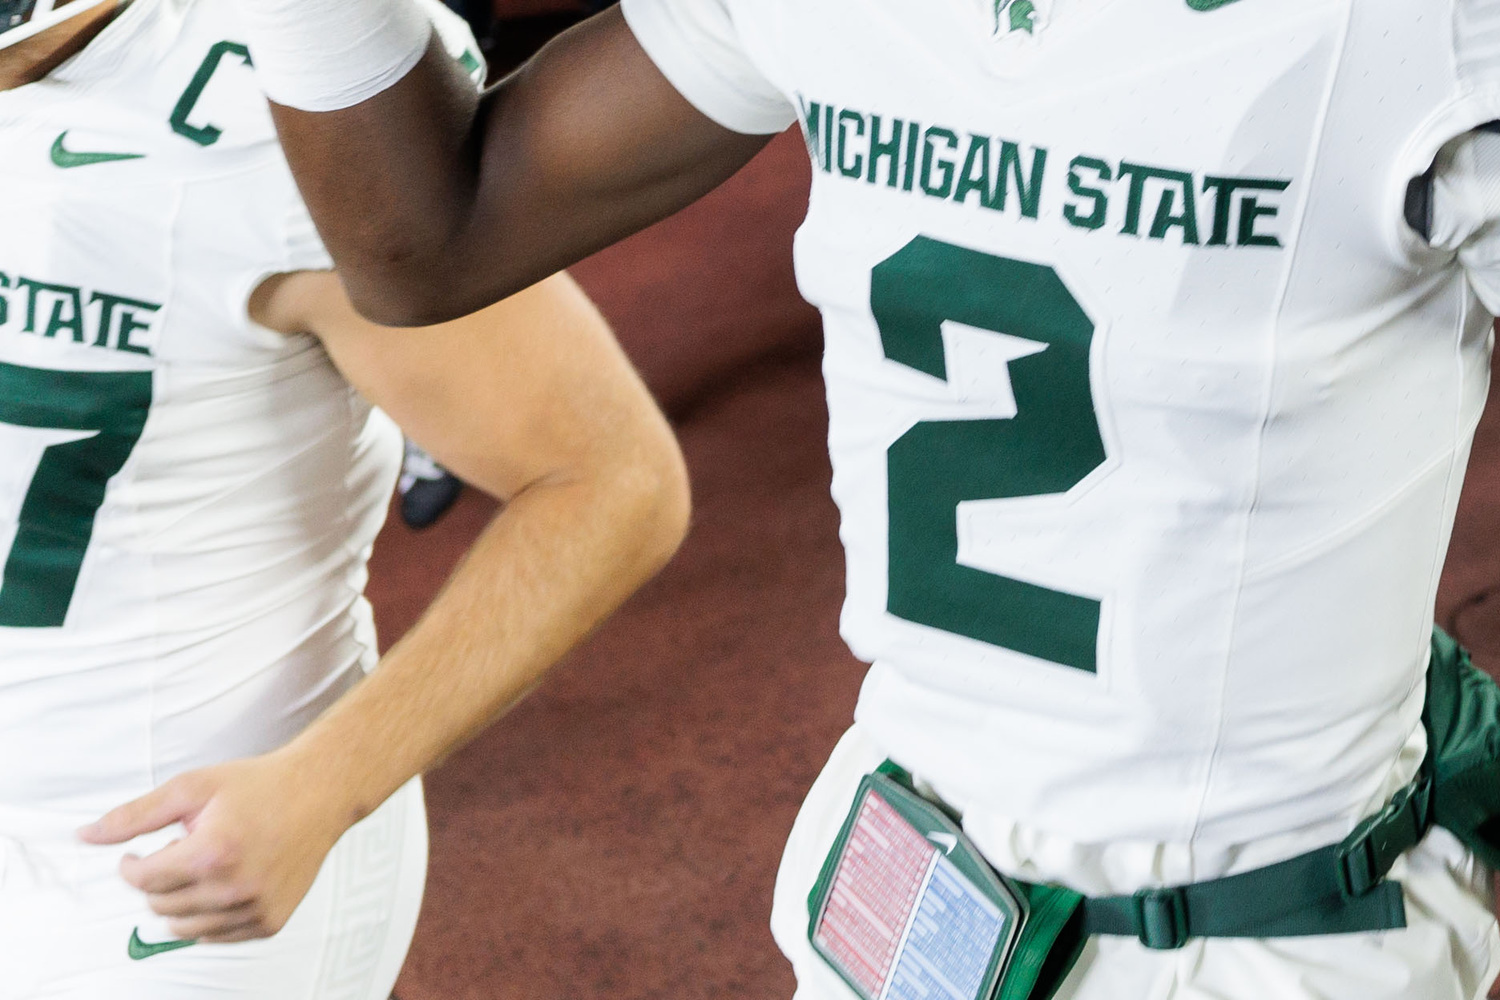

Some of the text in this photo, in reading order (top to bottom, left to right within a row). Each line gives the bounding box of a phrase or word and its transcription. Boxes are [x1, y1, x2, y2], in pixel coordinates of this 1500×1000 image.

[169, 39, 255, 146] C
[1062, 153, 1293, 249] STATE
[0, 270, 164, 357] TATE
[869, 233, 1108, 674] 2
